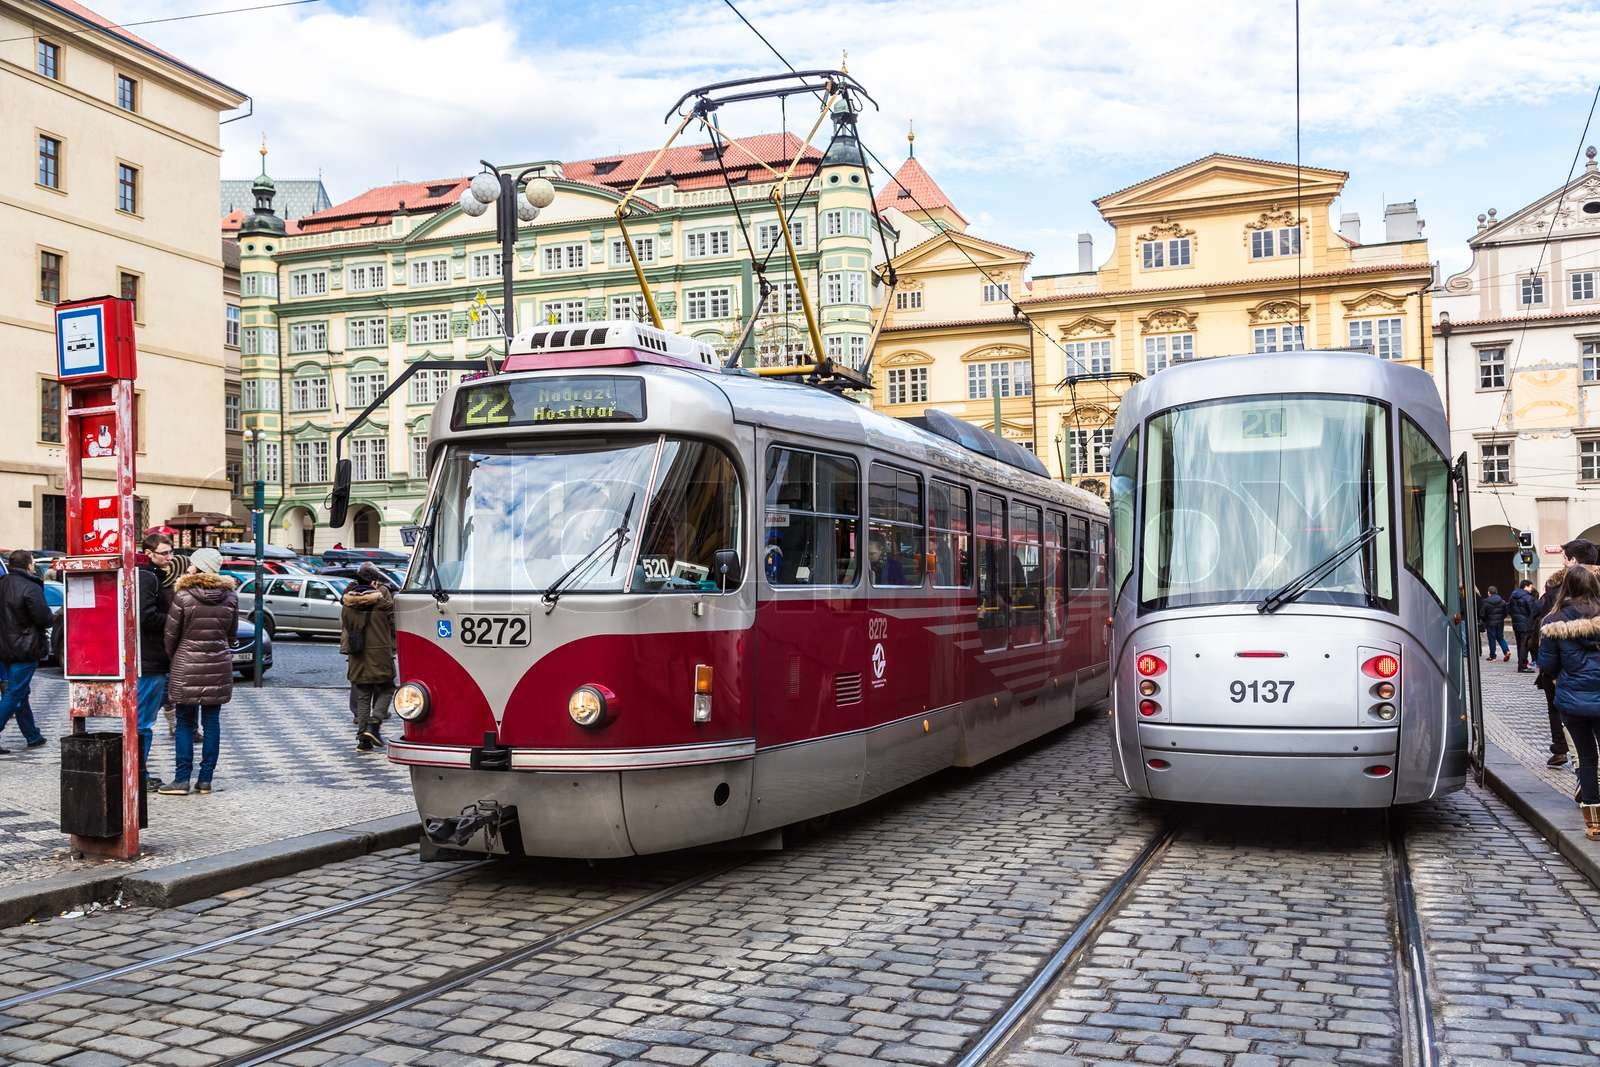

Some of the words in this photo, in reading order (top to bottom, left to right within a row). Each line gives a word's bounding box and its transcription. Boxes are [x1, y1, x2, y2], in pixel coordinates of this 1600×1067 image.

[466, 387, 509, 425] 22
[642, 558, 670, 578] 520
[460, 617, 527, 645] 8272
[868, 617, 888, 640] 8272
[1229, 679, 1296, 704] 9137
